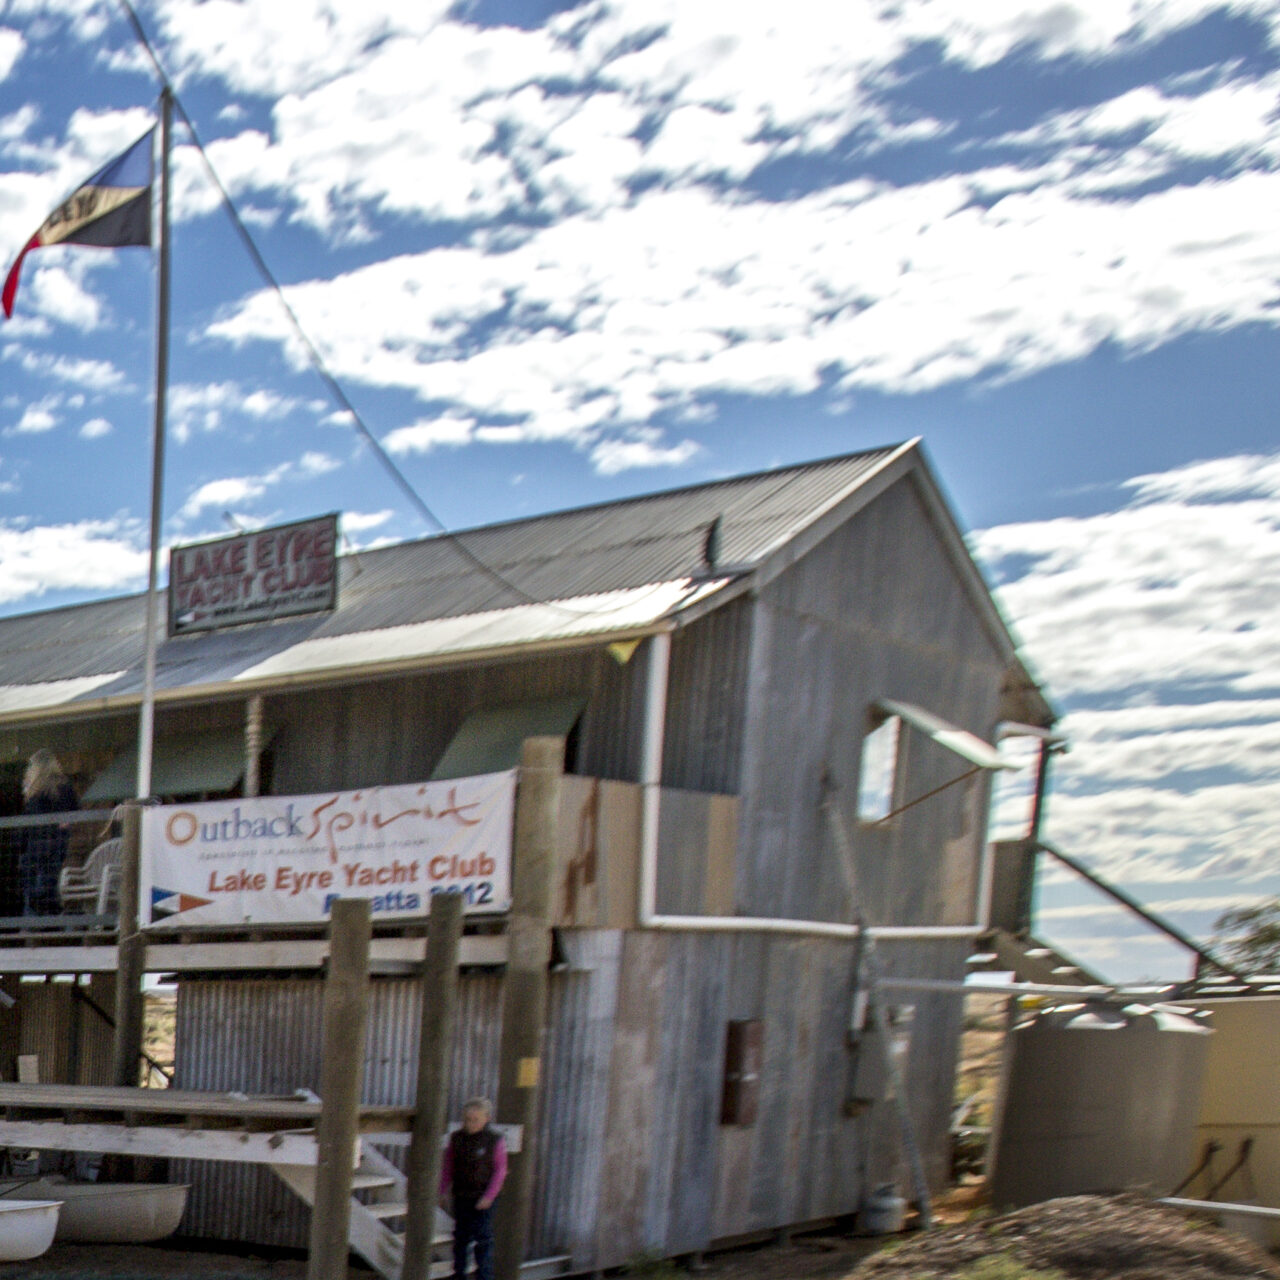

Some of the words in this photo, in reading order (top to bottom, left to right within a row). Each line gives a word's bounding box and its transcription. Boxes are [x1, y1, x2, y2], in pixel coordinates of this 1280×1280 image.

[178, 542, 247, 582] LAKE
[254, 524, 333, 570] EYRE
[175, 574, 254, 609] YACHT
[262, 559, 334, 595] CLUB
[165, 804, 306, 846] Outback
[306, 786, 481, 864] Spirit
[208, 866, 267, 893] Lake
[274, 865, 334, 896] Eyre
[341, 858, 419, 888] Yacht
[428, 851, 497, 882] Club
